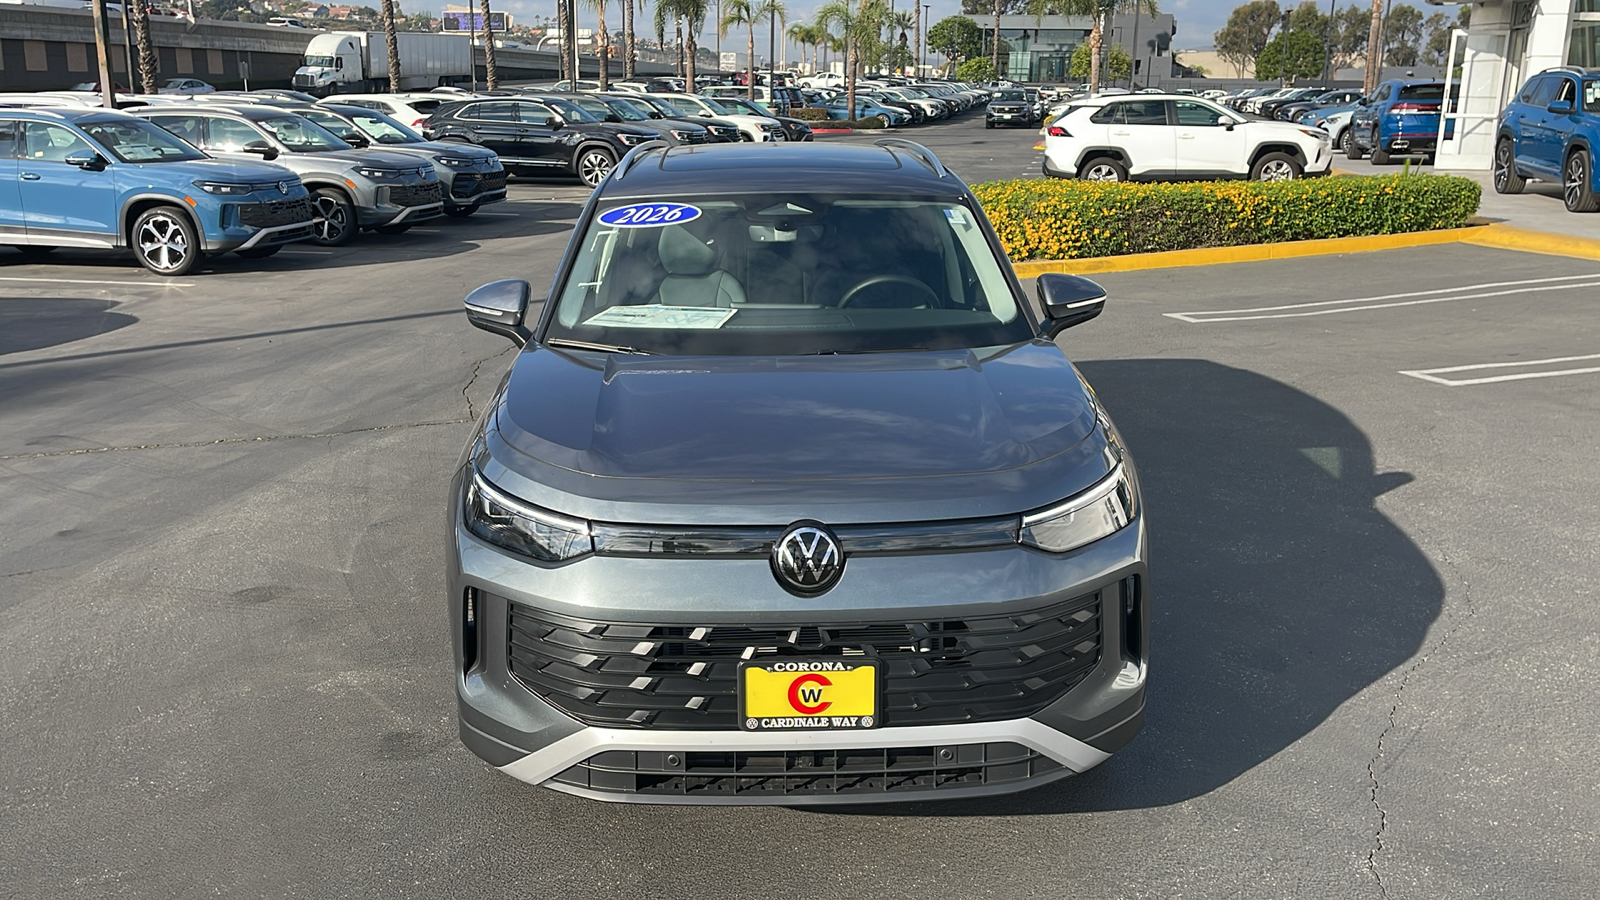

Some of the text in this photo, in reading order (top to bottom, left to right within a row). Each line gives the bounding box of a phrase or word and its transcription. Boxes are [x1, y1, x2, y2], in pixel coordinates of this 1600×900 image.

[613, 205, 689, 224] 2026
[773, 662, 846, 672] CORONA
[787, 673, 833, 715] C
[801, 688, 823, 703] W
[761, 717, 859, 728] CARDINALE WAY
